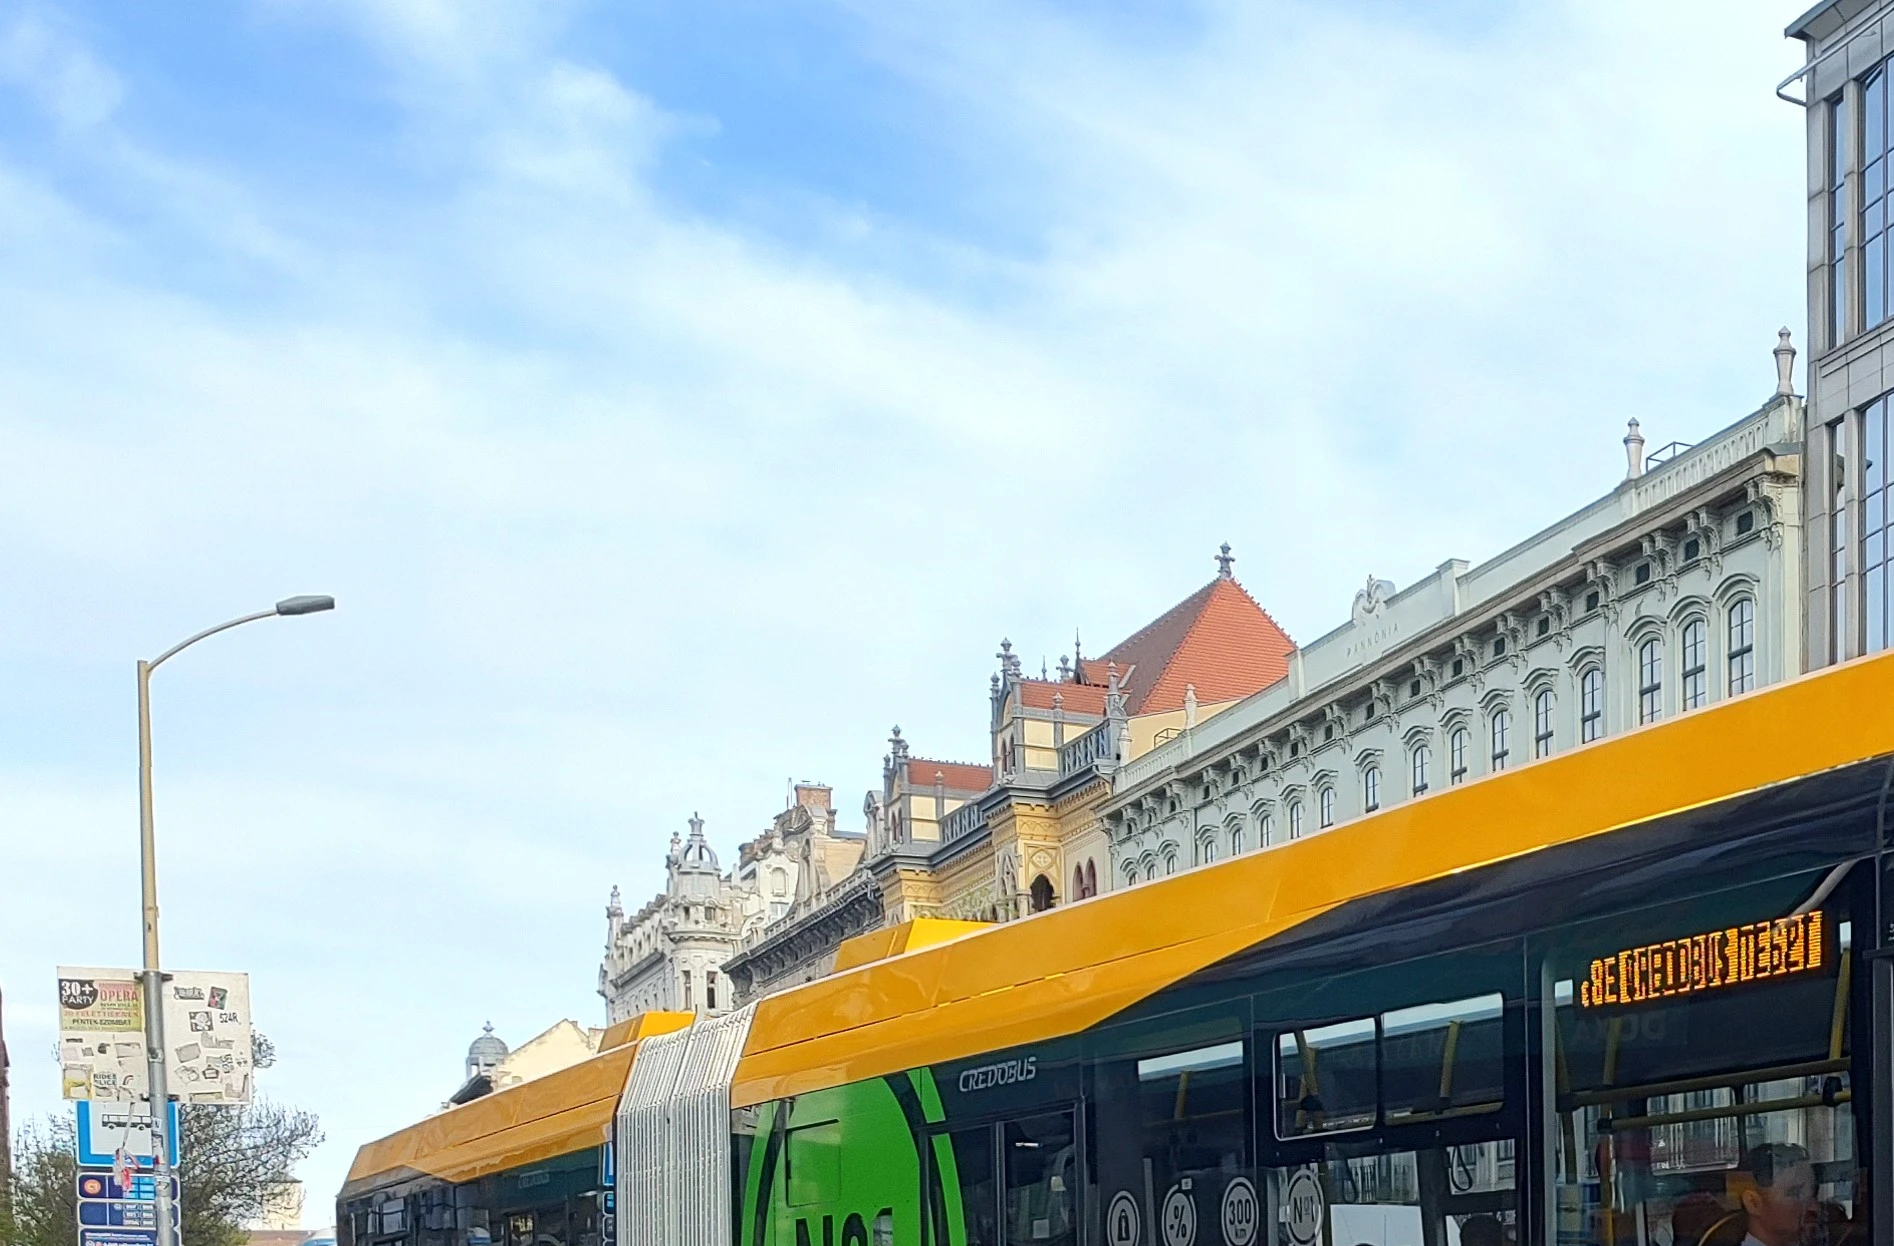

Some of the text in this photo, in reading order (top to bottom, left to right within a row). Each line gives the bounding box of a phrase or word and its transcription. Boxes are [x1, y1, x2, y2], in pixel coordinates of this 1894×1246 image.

[61, 981, 93, 996] 30+
[62, 996, 94, 1004] PARTY
[100, 990, 138, 1002] OPERA
[959, 1056, 1036, 1092] CREDOBUS
[1228, 1199, 1251, 1226] 300
[1235, 1225, 1247, 1239] km
